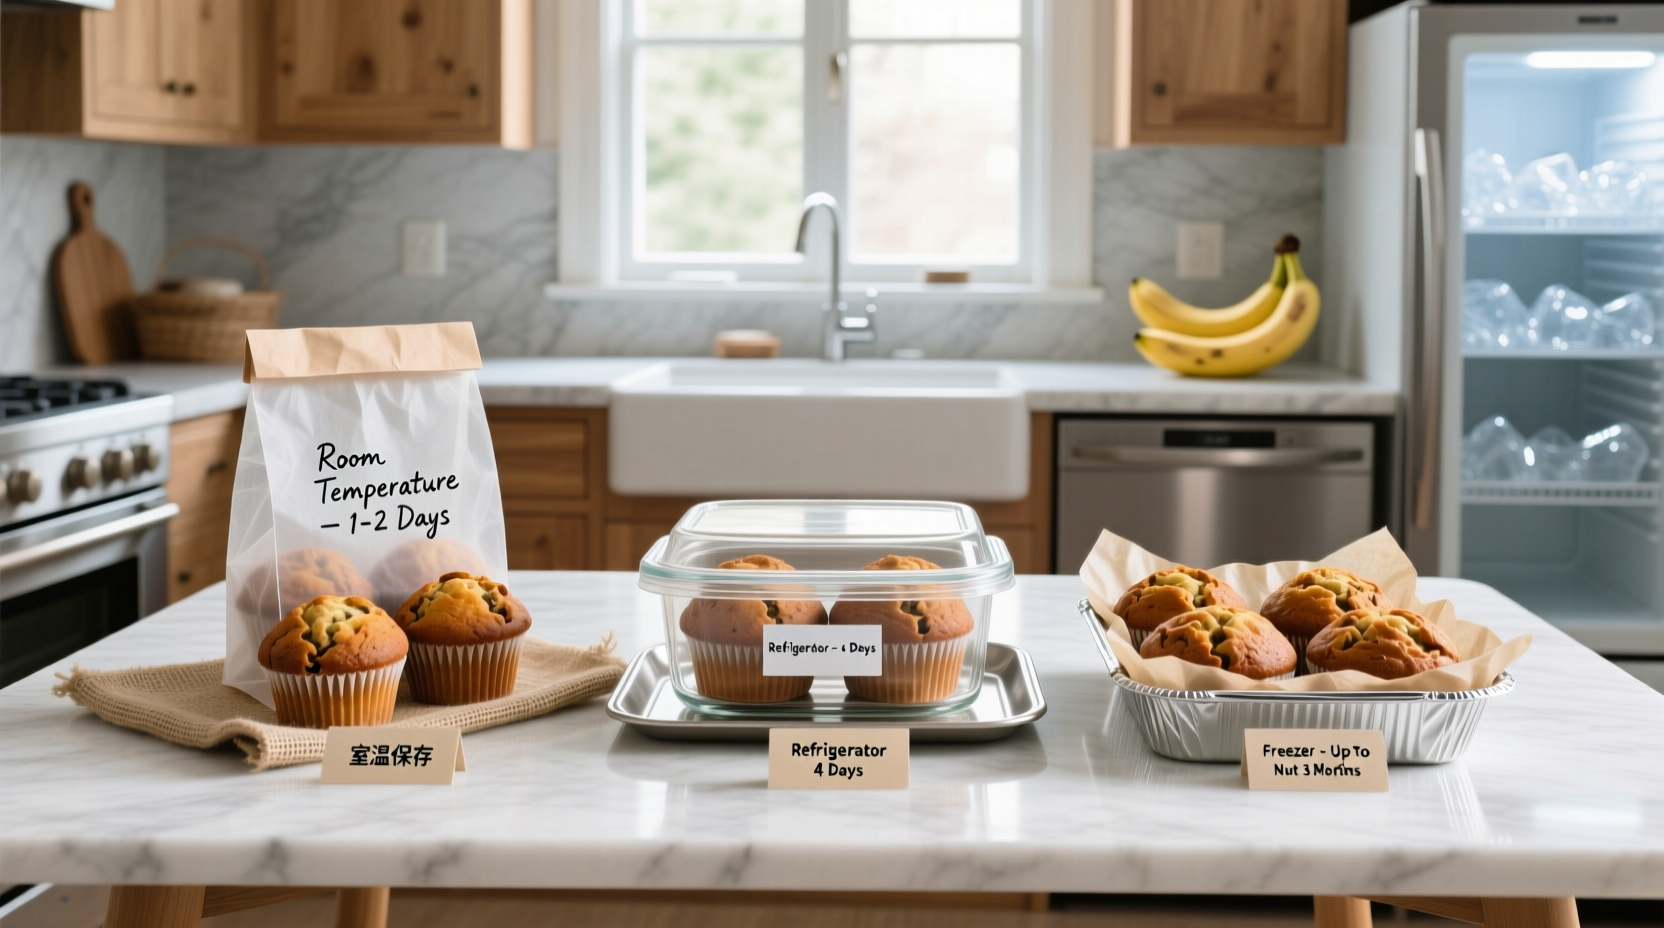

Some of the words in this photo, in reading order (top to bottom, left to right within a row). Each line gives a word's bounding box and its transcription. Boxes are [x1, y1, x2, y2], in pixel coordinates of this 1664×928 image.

[317, 442, 386, 472] Room
[314, 471, 460, 510] Temperature
[350, 510, 388, 535] 1-2
[397, 504, 450, 539] Days
[349, 743, 434, 767] 室温保存
[791, 742, 887, 761] Refrigerator
[1263, 744, 1315, 758] Freezer
[1330, 744, 1351, 760] Up
[1352, 745, 1371, 758] To
[813, 762, 824, 777] 4
[828, 762, 864, 780] Days
[1274, 763, 1299, 776] Nut
[1303, 764, 1310, 776] 3
